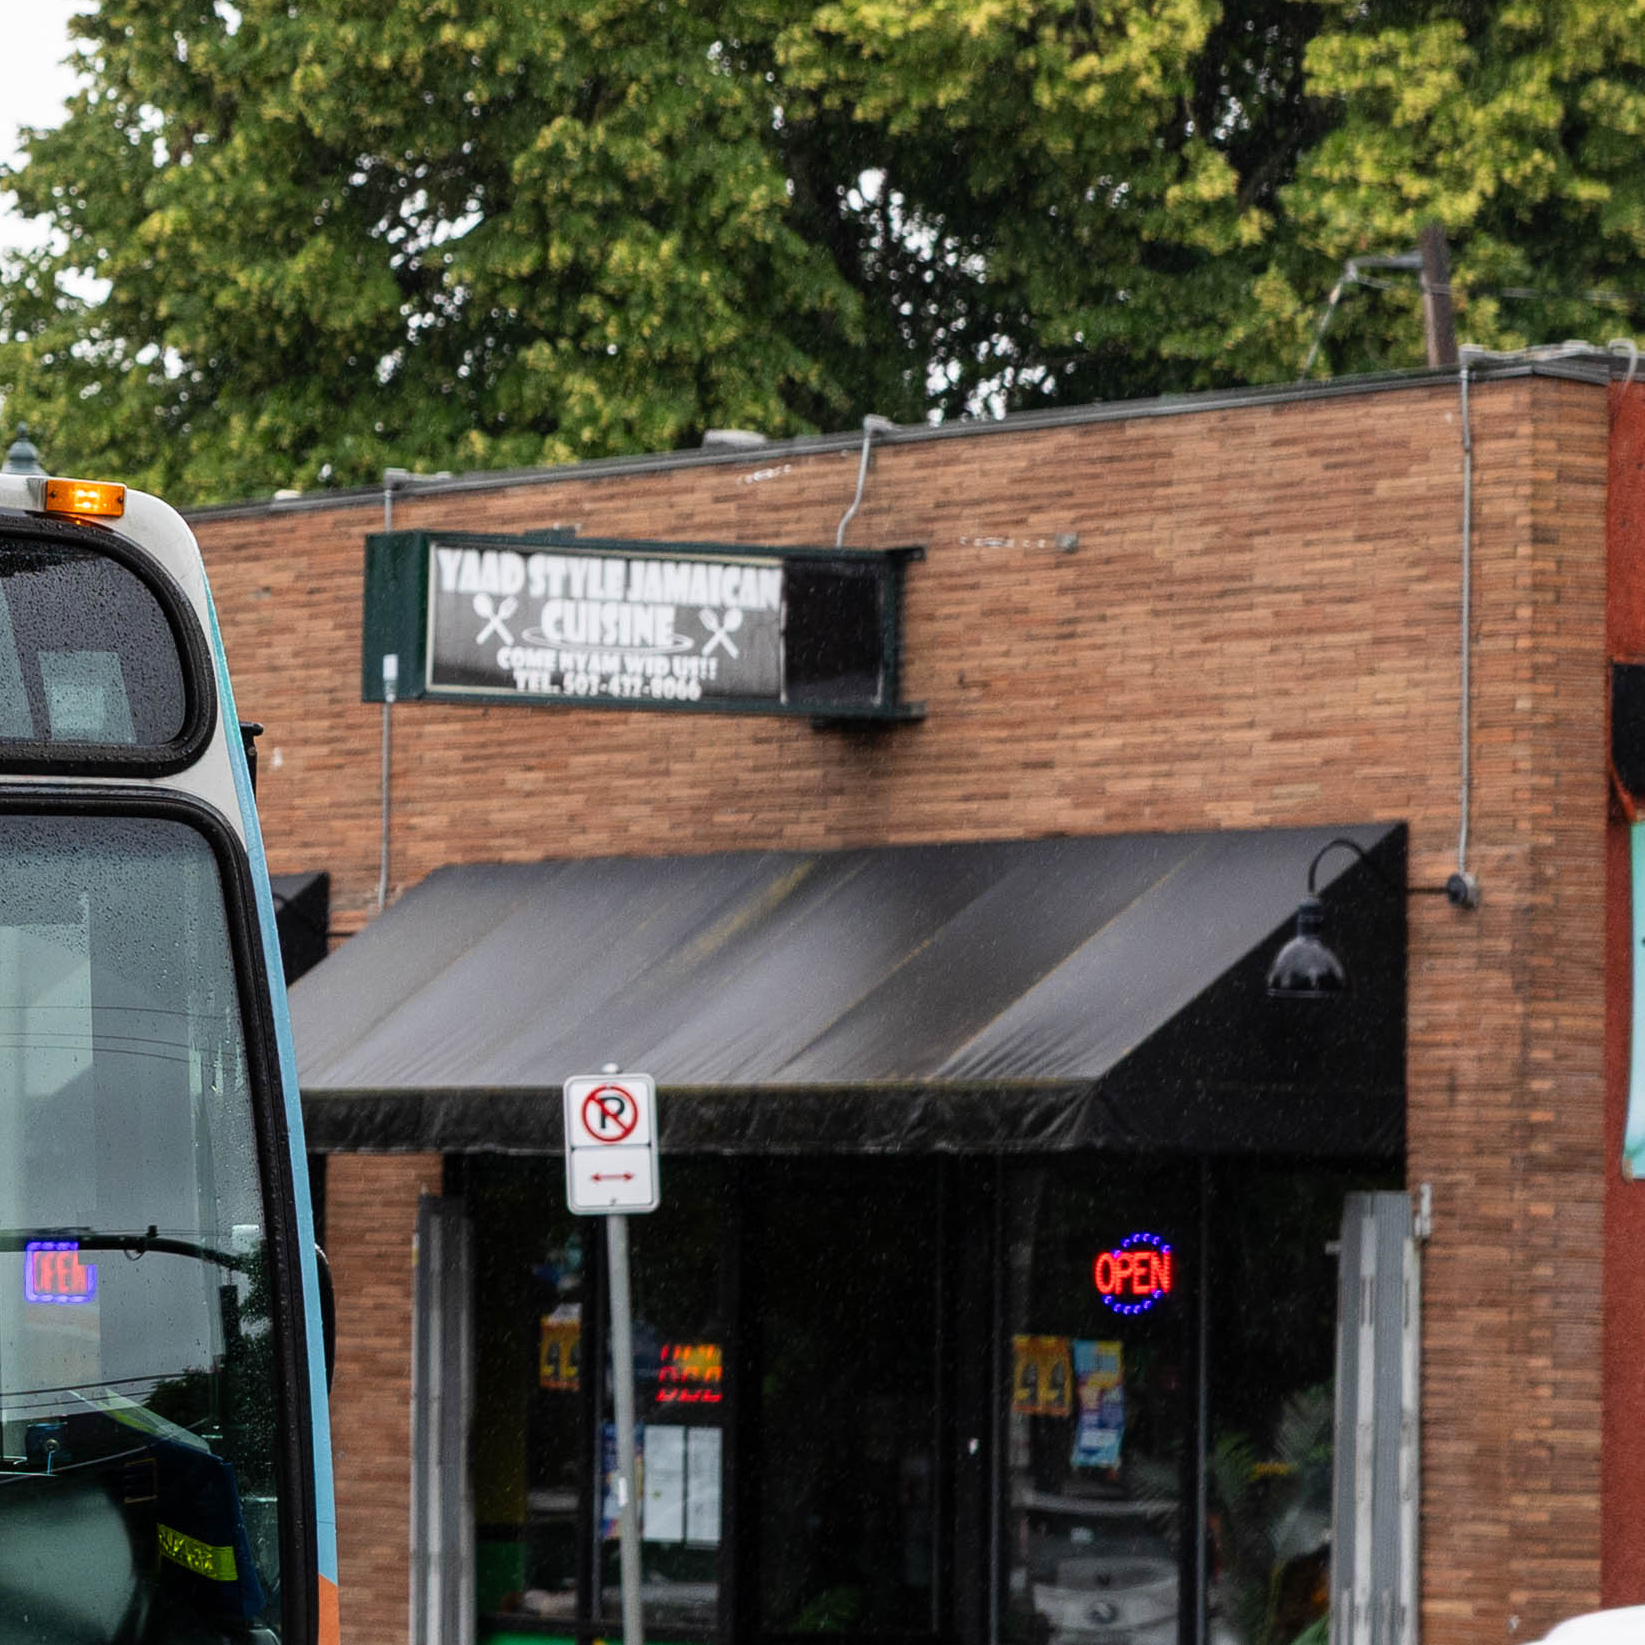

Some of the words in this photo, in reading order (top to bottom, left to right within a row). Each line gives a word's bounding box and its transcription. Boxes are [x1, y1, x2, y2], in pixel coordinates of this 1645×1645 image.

[437, 548, 527, 596] YAAD
[528, 553, 625, 601] STYLE
[626, 559, 784, 611] JAMAICAN
[541, 598, 676, 646] CUISINE
[497, 646, 557, 671] COME
[513, 668, 562, 694] TEL.
[1094, 1252, 1171, 1295] OPEN
